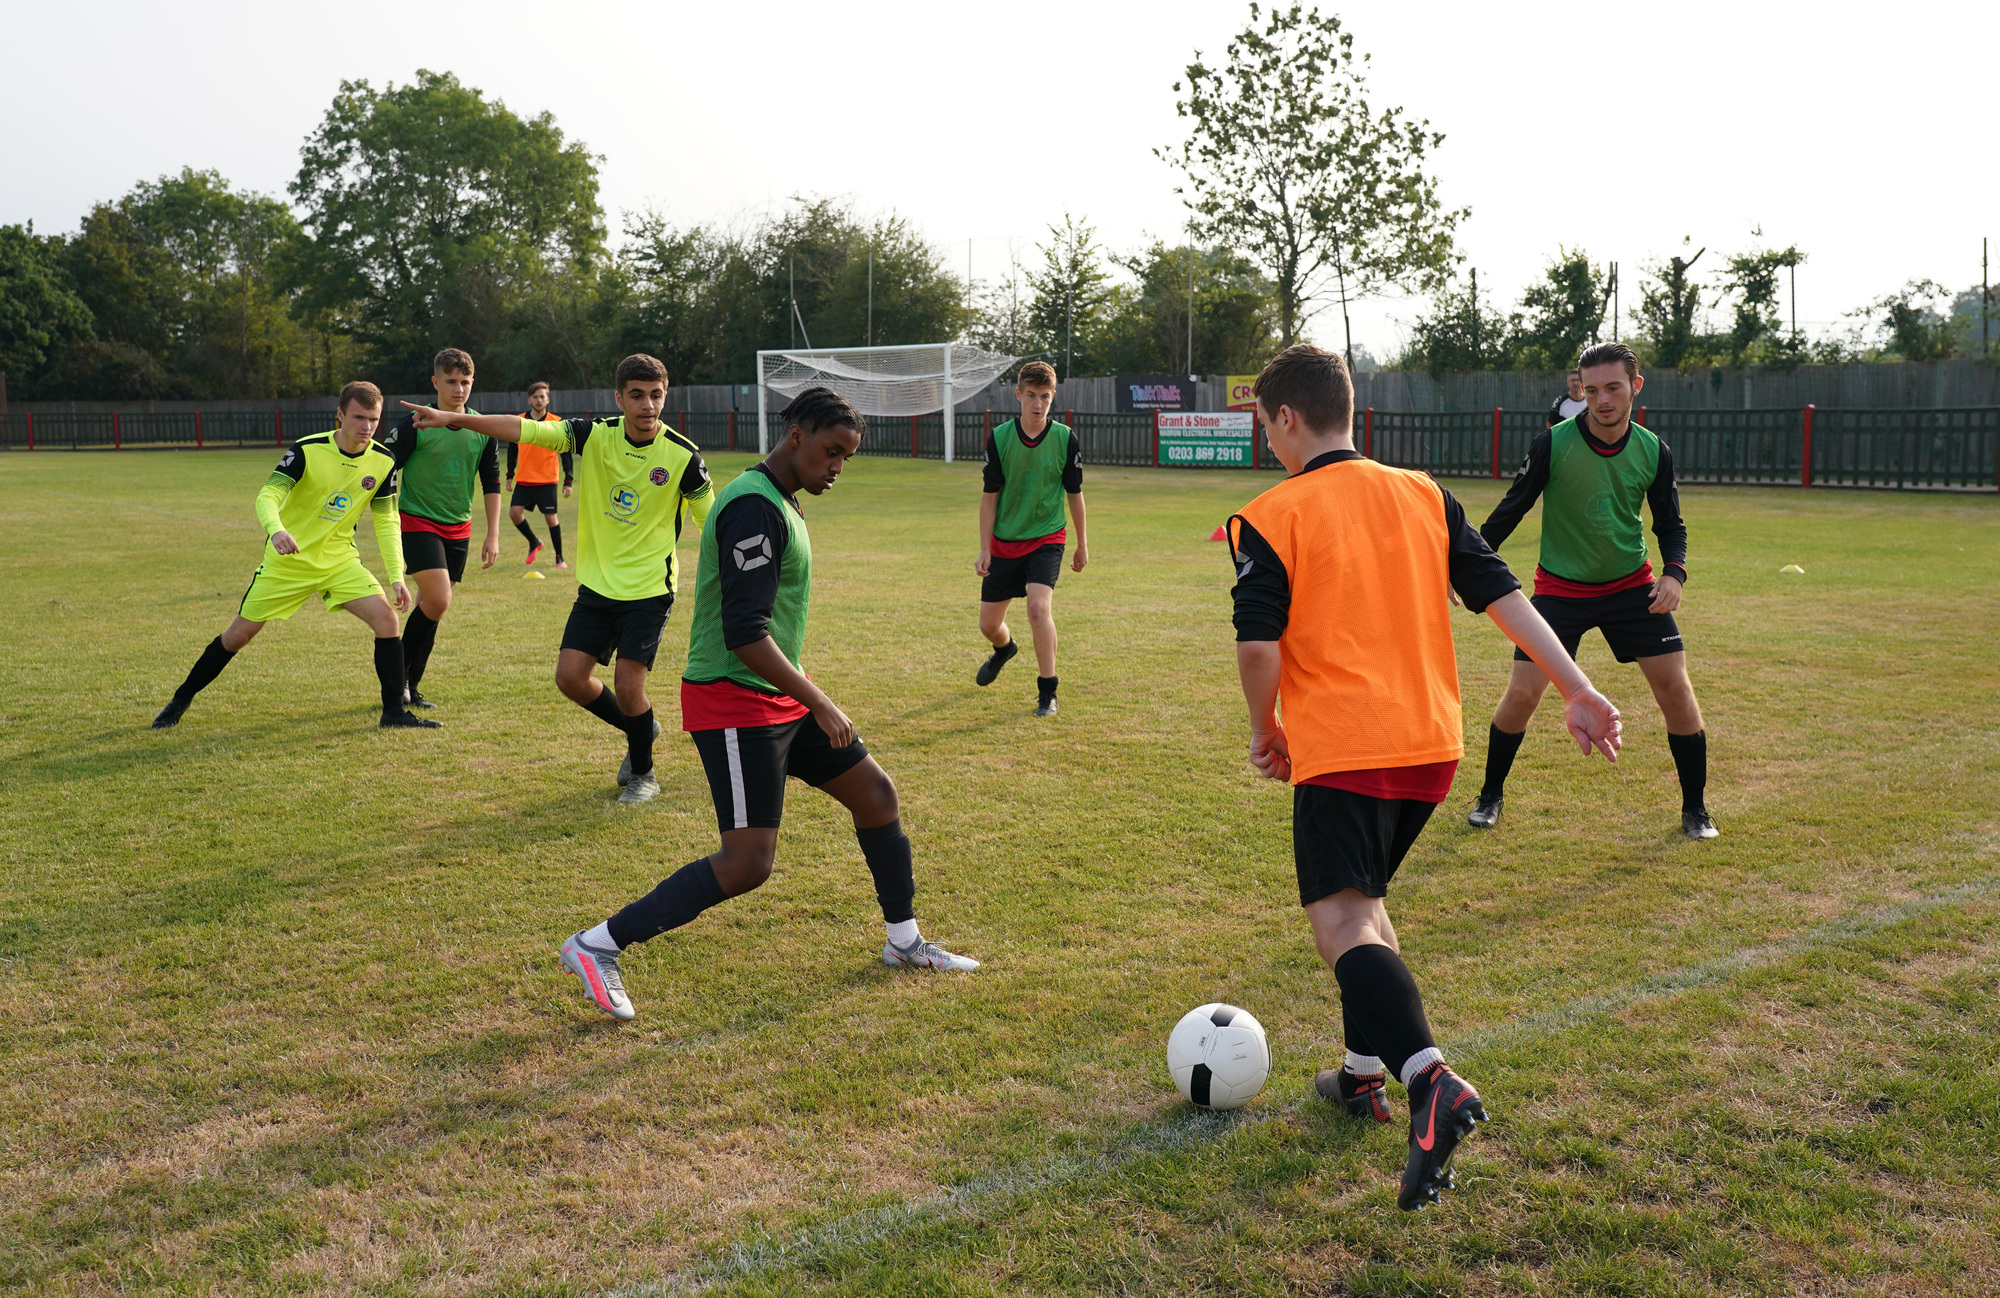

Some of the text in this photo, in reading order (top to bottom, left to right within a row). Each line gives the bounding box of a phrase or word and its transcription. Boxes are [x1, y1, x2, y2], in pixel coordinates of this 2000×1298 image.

[1129, 385, 1181, 401] TalkTalk
[1232, 385, 1256, 400] CR
[1160, 415, 1183, 427] Grant
[1185, 415, 1191, 427] &
[1194, 415, 1219, 427] Stone
[1183, 429, 1212, 437] ELECTRICAL
[1213, 430, 1252, 438] WHOLESALERS
[1168, 446, 1242, 461] 0203 869 2918
[329, 496, 347, 508] JC
[613, 490, 634, 506] JC
